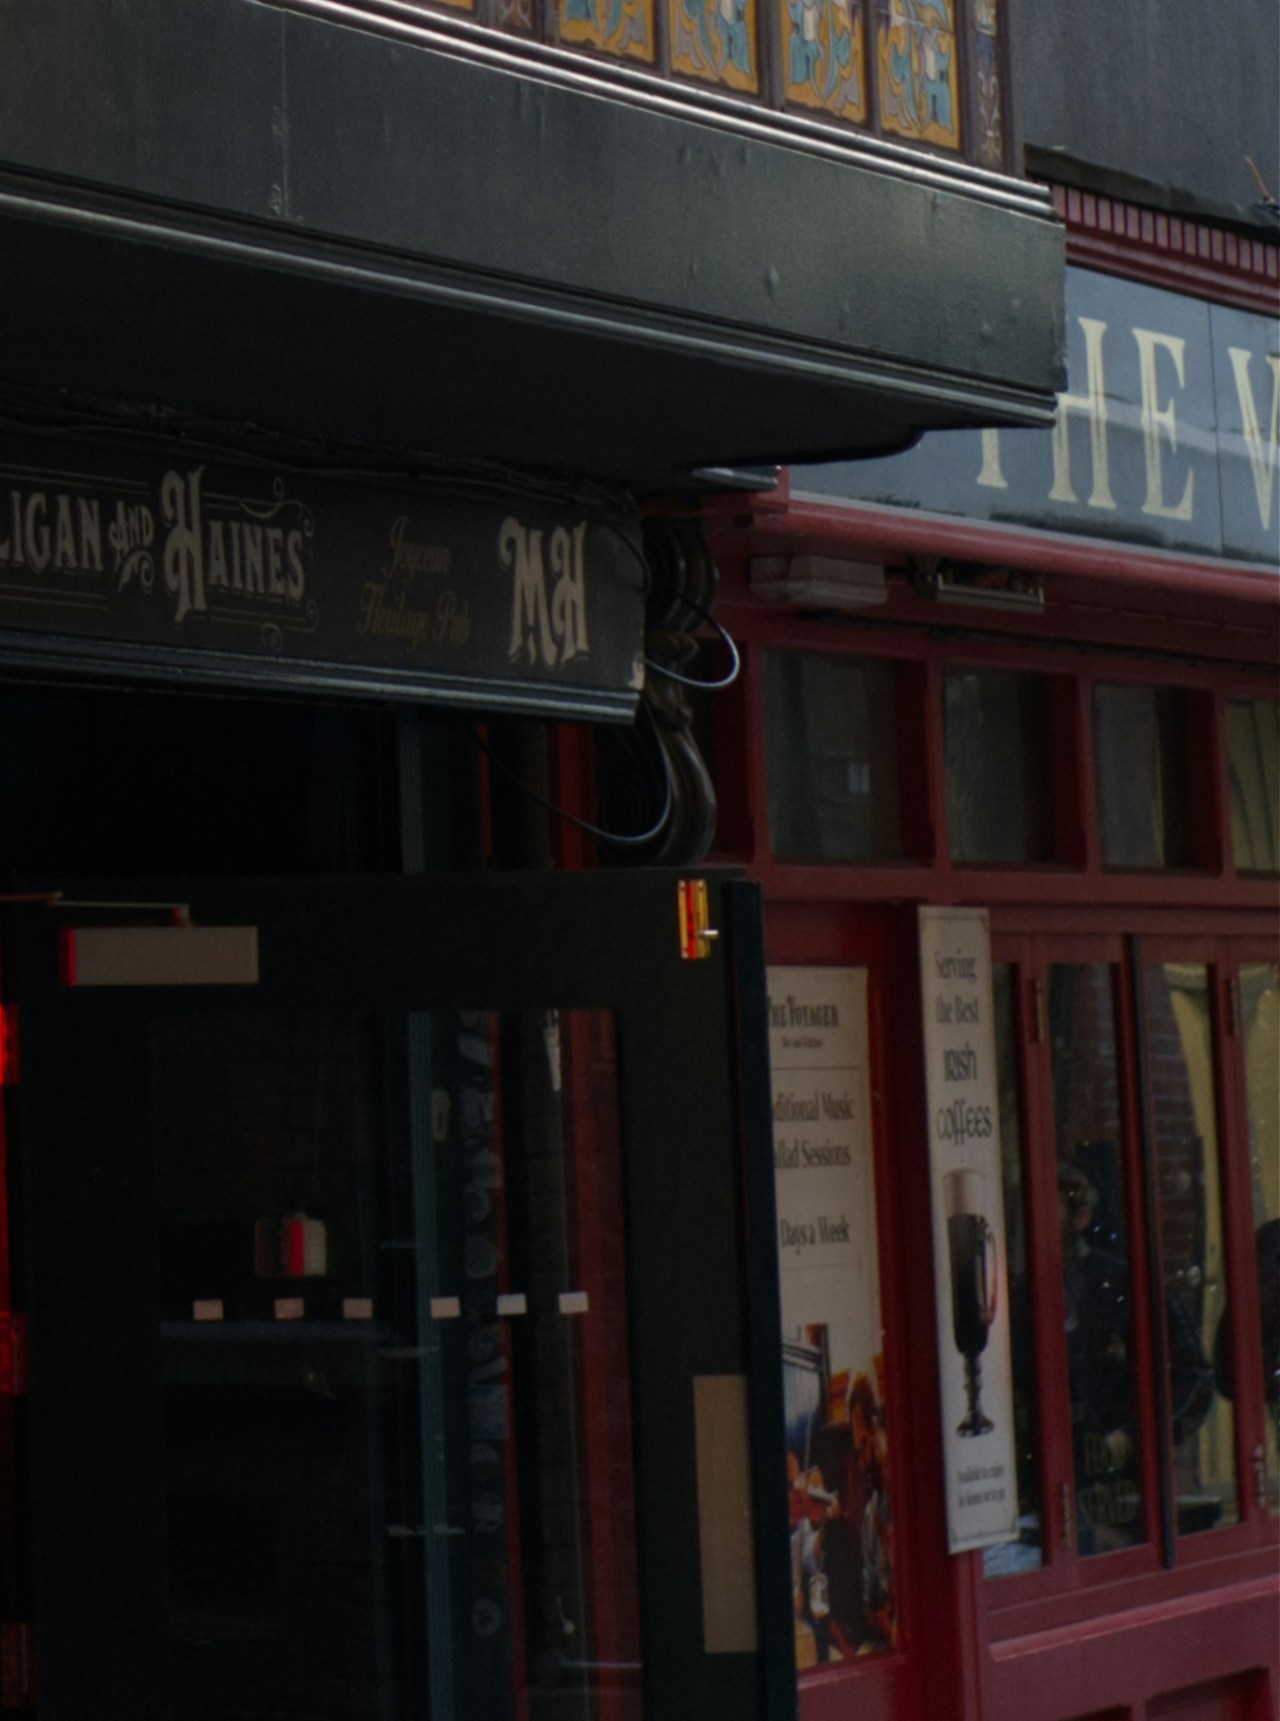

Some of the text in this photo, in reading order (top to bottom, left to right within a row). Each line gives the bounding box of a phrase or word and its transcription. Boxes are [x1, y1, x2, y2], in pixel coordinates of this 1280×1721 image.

[496, 514, 591, 667] MH
[431, 589, 471, 646] Pub
[935, 948, 977, 985] Serving
[935, 993, 981, 1024] the Best
[821, 1090, 855, 1121] Music
[801, 1137, 852, 1168] Sessions
[780, 1217, 808, 1256] Days
[817, 1213, 851, 1245] Week
